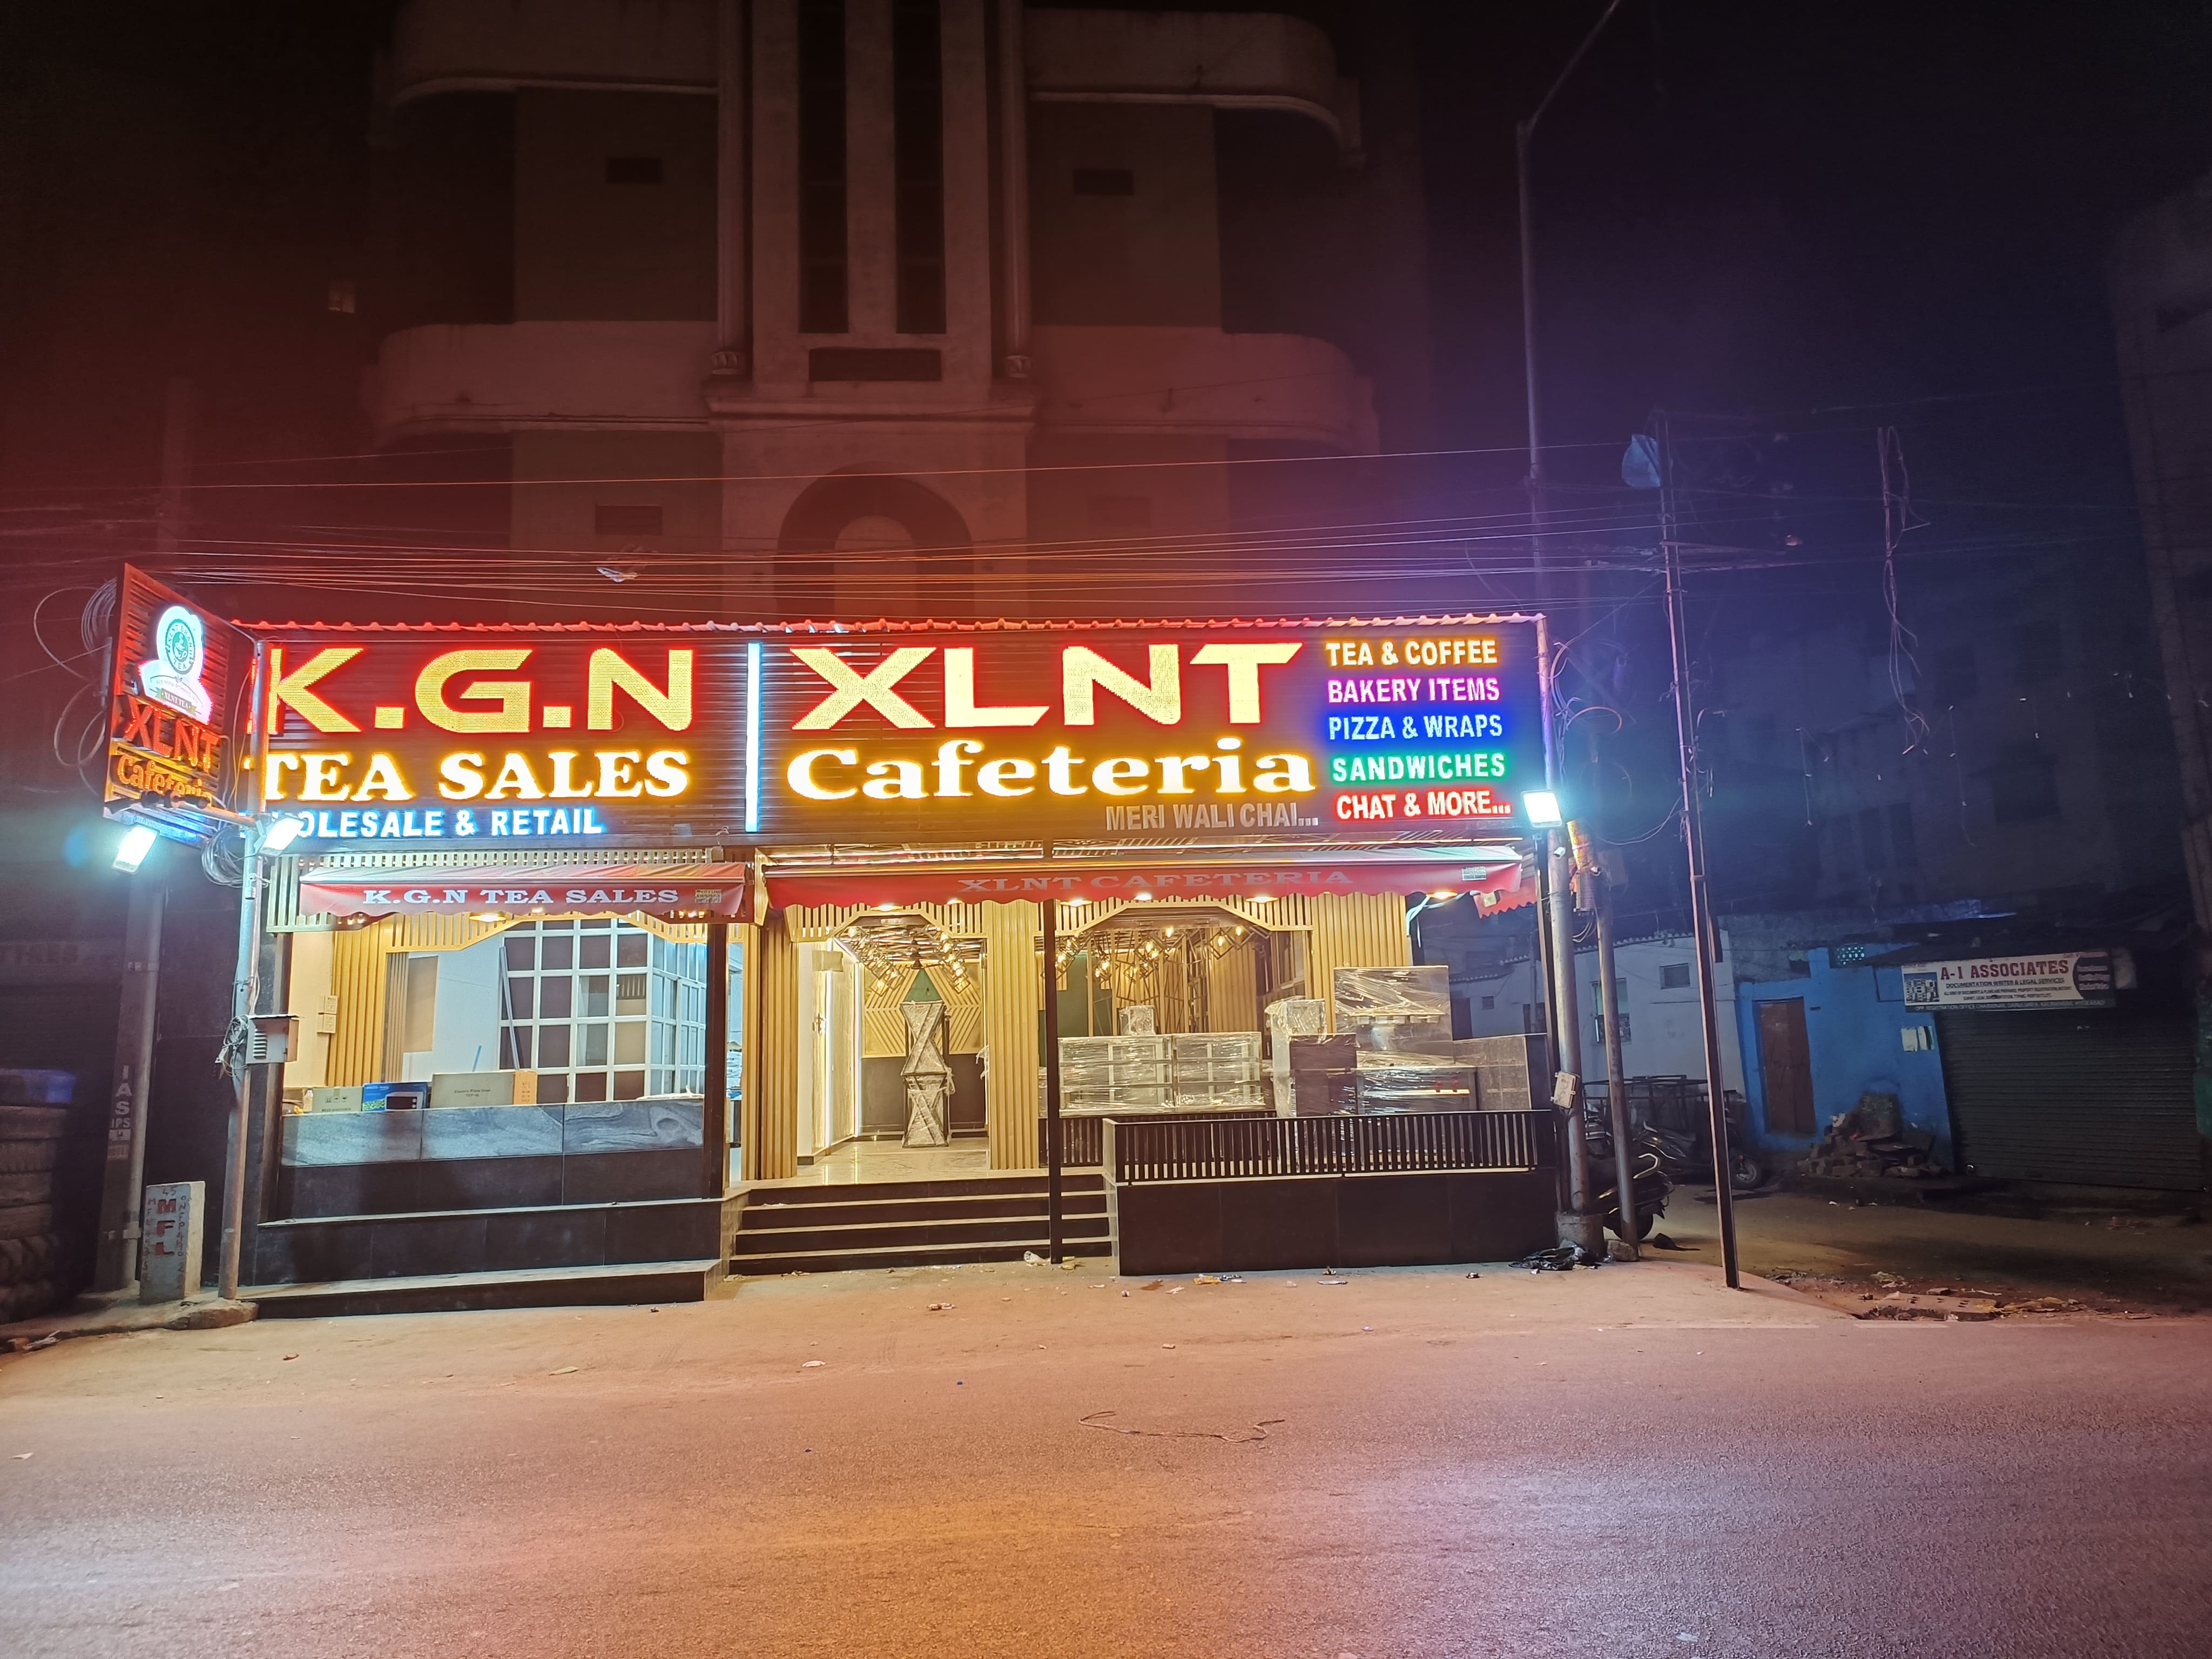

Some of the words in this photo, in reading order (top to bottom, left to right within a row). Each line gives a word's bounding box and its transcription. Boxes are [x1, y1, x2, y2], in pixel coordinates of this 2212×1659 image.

[1326, 641, 1374, 667] TEA
[1381, 641, 1399, 666] &
[1405, 639, 1498, 666] COFFEE
[247, 647, 694, 734] K.G.N
[789, 642, 1304, 730] XLNT
[1327, 678, 1422, 703] BAKERY
[1428, 677, 1500, 701] ITEMS
[124, 694, 220, 774] XLNT
[1328, 716, 1395, 740] PIZZA
[1401, 716, 1419, 739] &
[1424, 714, 1503, 738] WRAPS
[241, 751, 416, 802] TEA
[439, 748, 689, 800] SALES
[786, 737, 1317, 800] Cafeteria
[1332, 753, 1506, 783] SANDWICHES
[1105, 804, 1165, 832] MERI
[1174, 802, 1235, 830] WALI
[1337, 793, 1397, 820] CHAT
[1404, 792, 1421, 817] &
[1427, 790, 1512, 817] MORE...
[455, 809, 475, 837] &
[491, 807, 604, 837] RETAIL
[363, 889, 468, 905] K.G.N
[480, 889, 554, 905] TEA
[565, 889, 679, 904] SALES
[957, 876, 1083, 893] XLNT
[1090, 871, 1354, 889] CAFETERIA
[1971, 959, 2069, 979] ASSOCIATES
